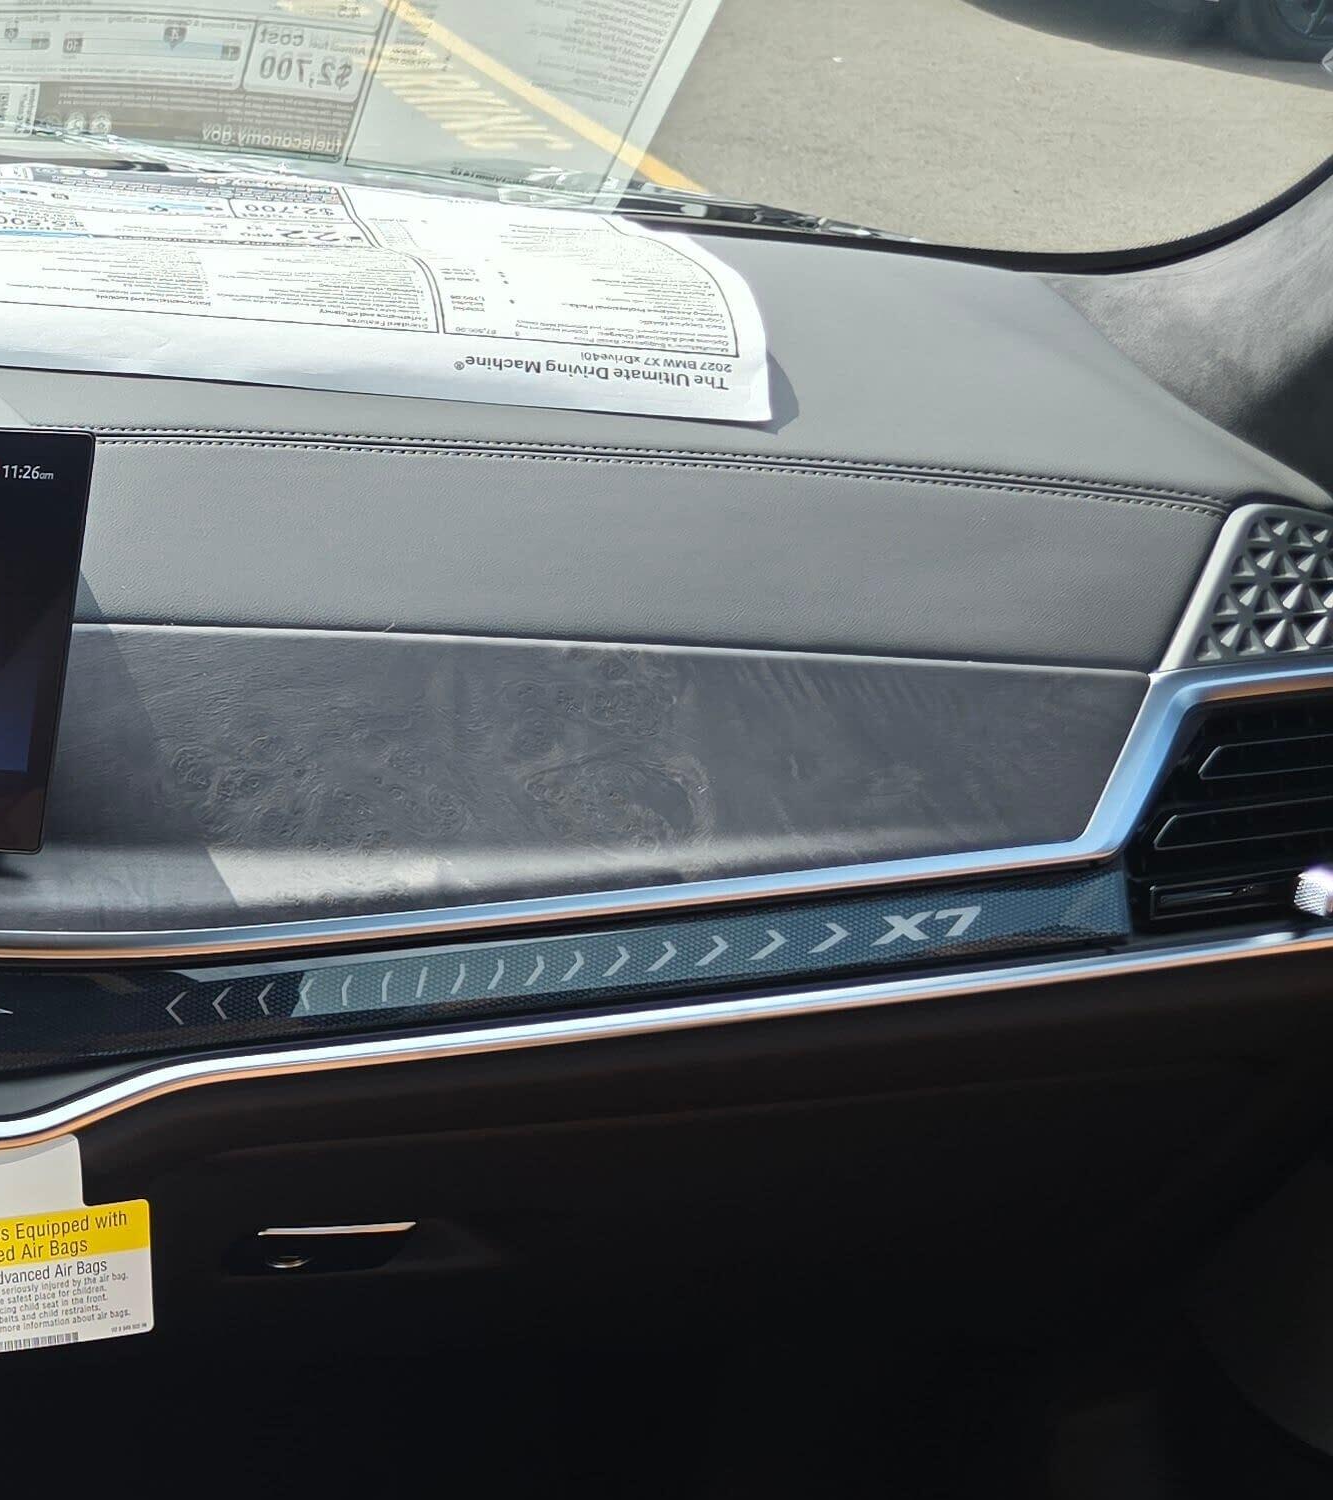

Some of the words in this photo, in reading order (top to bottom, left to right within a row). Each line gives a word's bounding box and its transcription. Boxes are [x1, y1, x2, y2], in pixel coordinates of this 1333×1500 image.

[546, 360, 609, 380] Driving
[644, 357, 660, 367] X7
[662, 358, 697, 370] BMW
[700, 362, 732, 373] 2027
[613, 368, 690, 387] Ultimate
[694, 375, 729, 391] The
[869, 905, 982, 947] X7
[15, 1214, 90, 1241] Equipped
[95, 1210, 128, 1229] with
[21, 1241, 45, 1260] Air
[50, 1237, 89, 1258] Bags
[54, 1263, 73, 1279] Air
[76, 1259, 108, 1277] Bags
[1, 1283, 39, 1296] seriously
[42, 1280, 70, 1291] injured
[72, 1279, 83, 1288] by
[84, 1276, 97, 1285] the
[99, 1274, 110, 1283] air
[7, 1294, 32, 1305] safest
[34, 1292, 56, 1303] place
[58, 1289, 70, 1298] for
[19, 1302, 40, 1312] child
[42, 1300, 59, 1309] seat
[61, 1298, 69, 1306] in
[71, 1296, 84, 1304] the
[0, 1314, 19, 1324] belts
[21, 1312, 36, 1321] and
[38, 1308, 59, 1318] child
[0, 1324, 21, 1333] more
[22, 1317, 70, 1330] information
[72, 1313, 95, 1324] about
[97, 1311, 108, 1319] air
